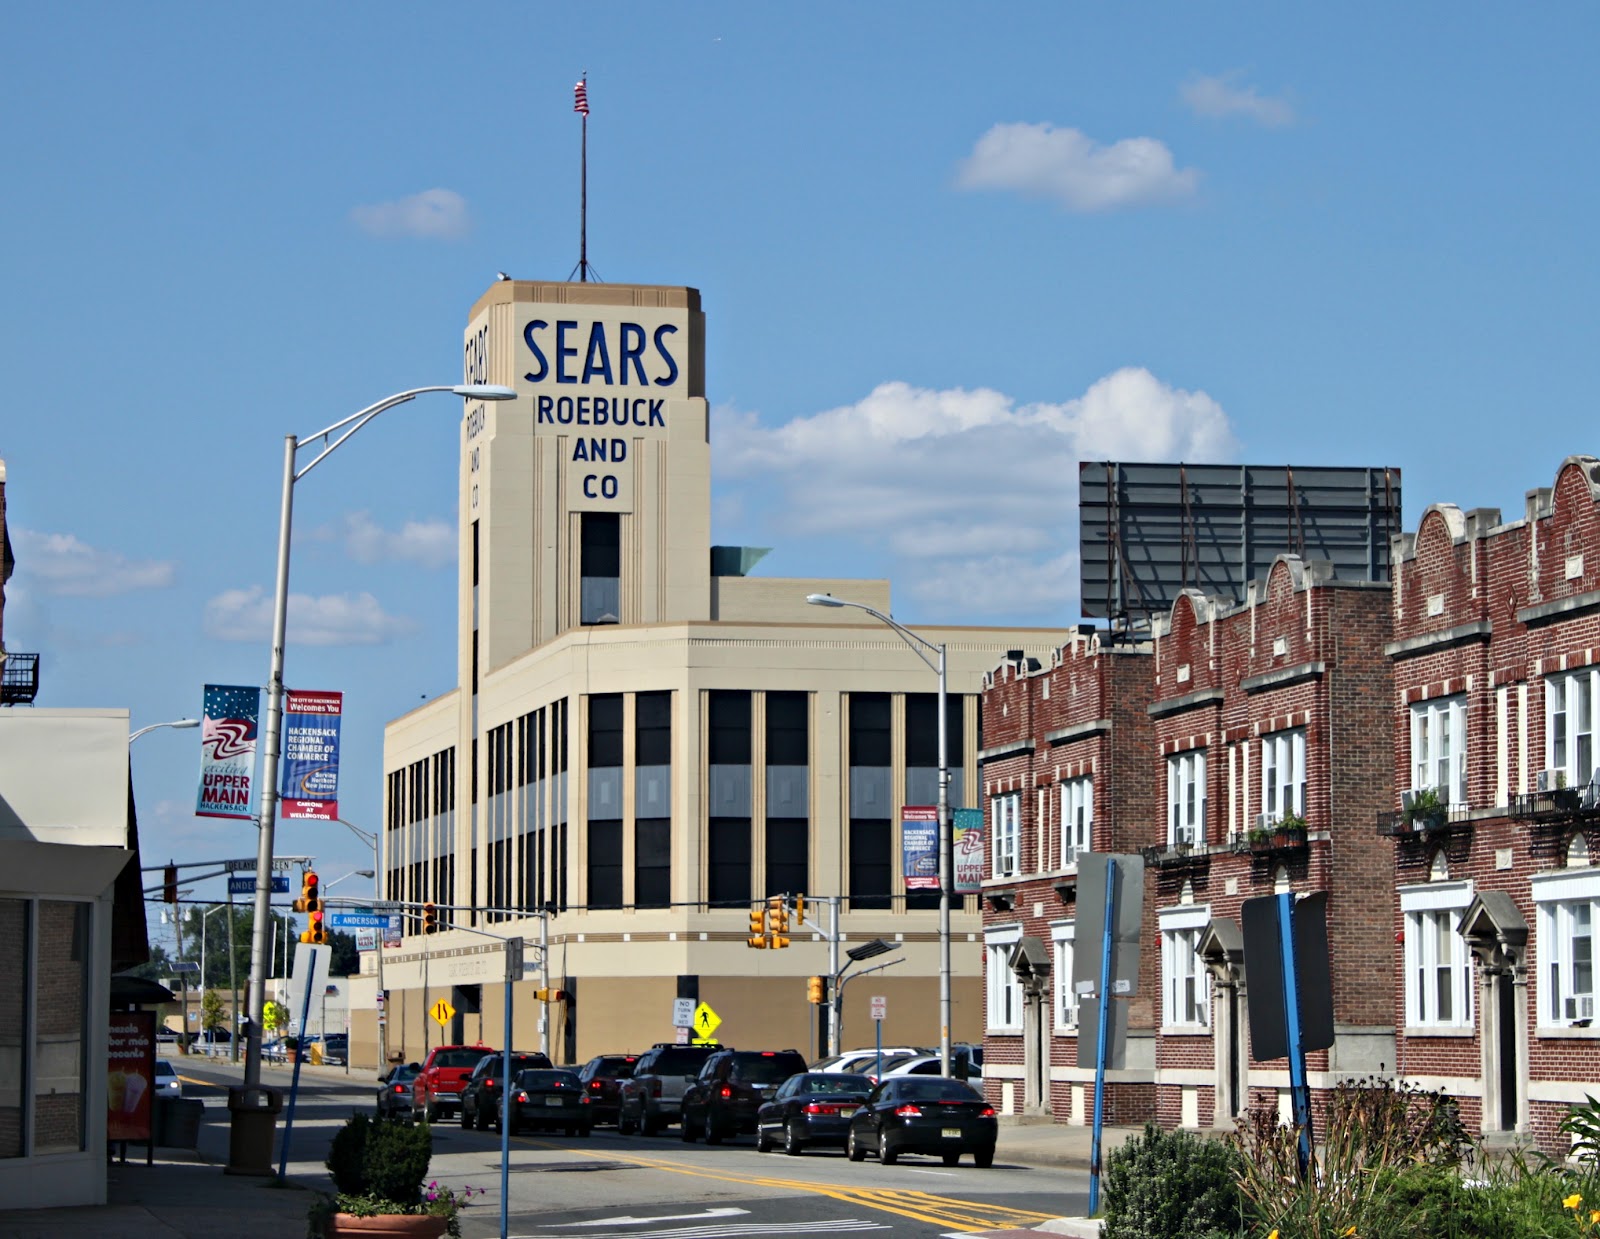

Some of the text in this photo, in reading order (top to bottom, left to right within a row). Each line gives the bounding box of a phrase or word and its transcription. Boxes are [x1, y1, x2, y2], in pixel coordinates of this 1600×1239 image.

[523, 319, 679, 387] SEARS
[537, 395, 665, 427] ROEBUCK
[572, 437, 627, 463] AND
[583, 474, 618, 499] CO
[291, 703, 340, 713] Welcomes You
[288, 727, 337, 737] HACKENSACK
[288, 736, 325, 745] REGIONAL
[287, 744, 335, 753] CHAMBER OF
[287, 752, 329, 762] COMMERCE
[203, 773, 250, 789] UPPER
[315, 772, 337, 780] Serving
[201, 787, 249, 806] MAIN
[200, 802, 248, 812] HACKENSACK
[290, 812, 330, 820] WELLINGTON
[229, 860, 258, 870] DELAYE
[230, 880, 278, 890] ANDEN
[333, 916, 340, 925] E.
[343, 916, 380, 926] ANDERSON
